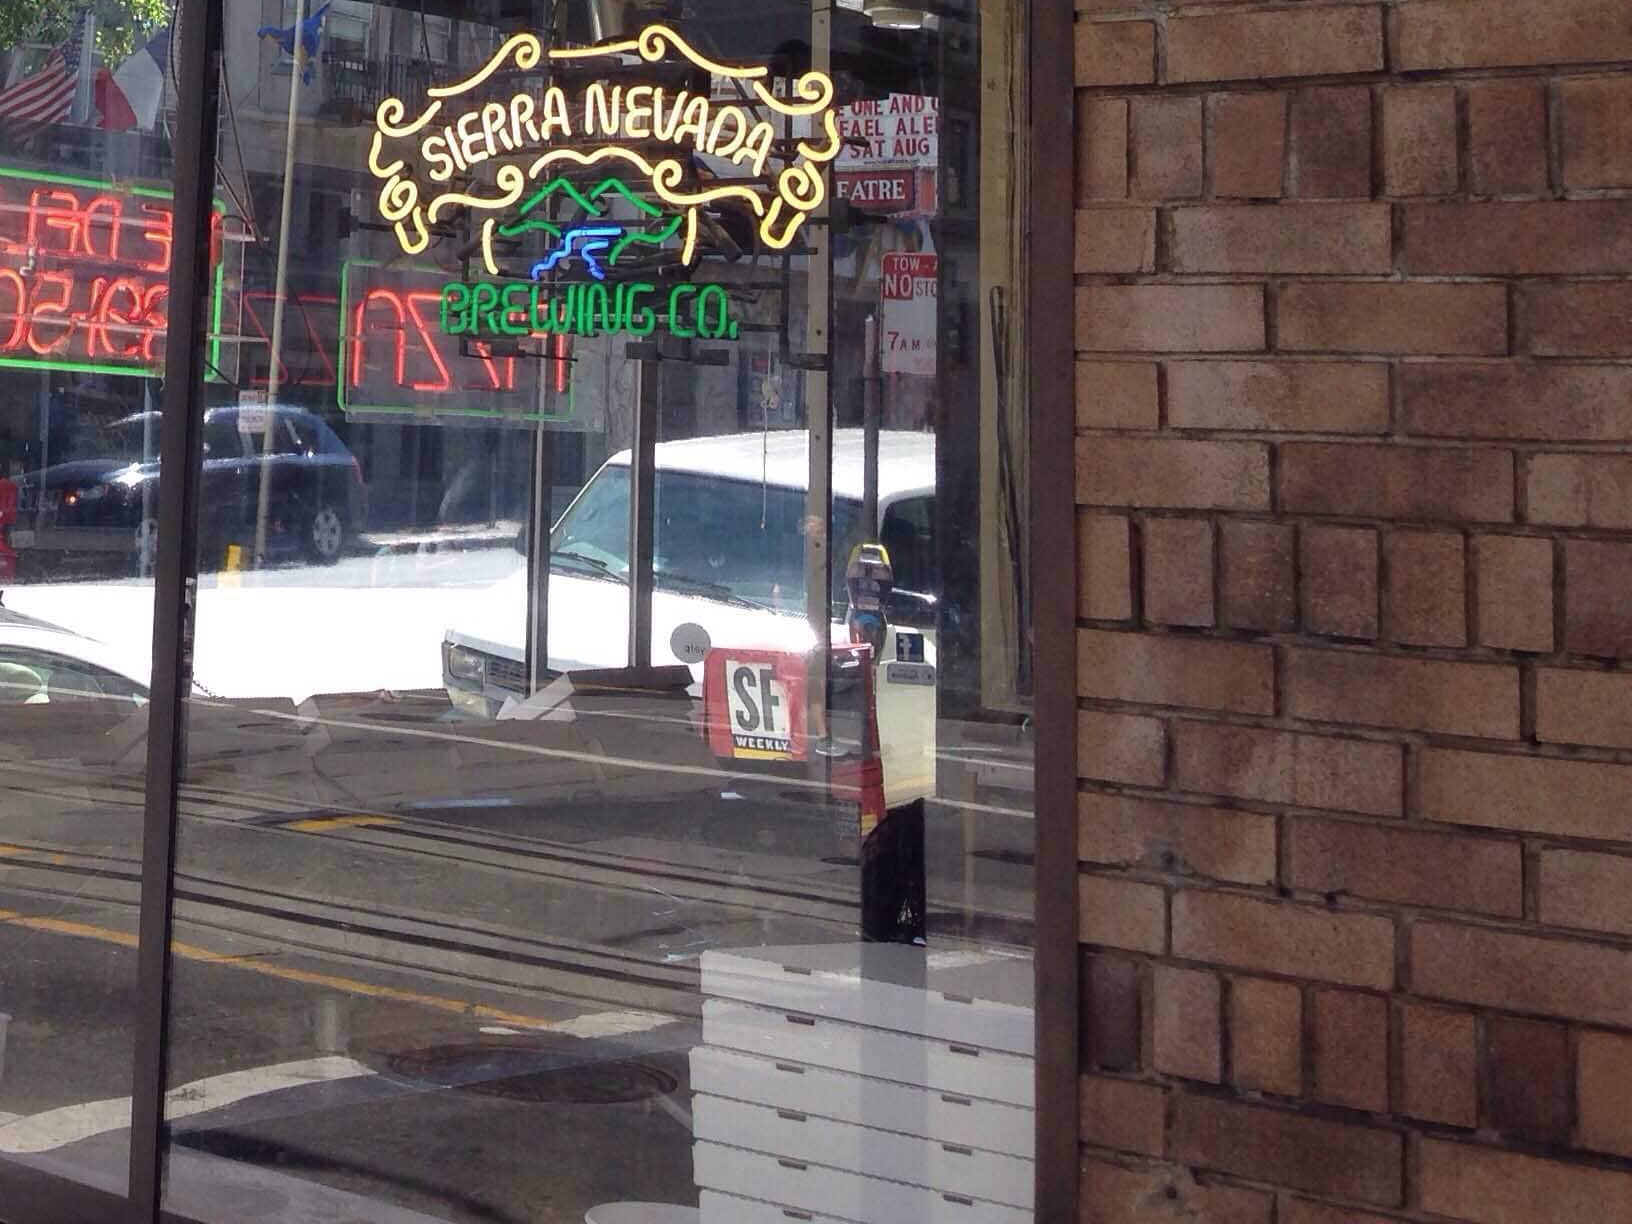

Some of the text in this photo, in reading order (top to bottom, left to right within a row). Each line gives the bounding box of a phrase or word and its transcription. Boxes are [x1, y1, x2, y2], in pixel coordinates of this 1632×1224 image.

[889, 95, 925, 114] AND
[421, 83, 775, 181] SIERRA NEVADA
[896, 115, 938, 136] ALE
[893, 137, 931, 157] AUG
[885, 274, 913, 297] NO
[439, 281, 739, 340] BREWING CO.
[733, 665, 781, 732] SF
[735, 735, 789, 751] WEEKLY
